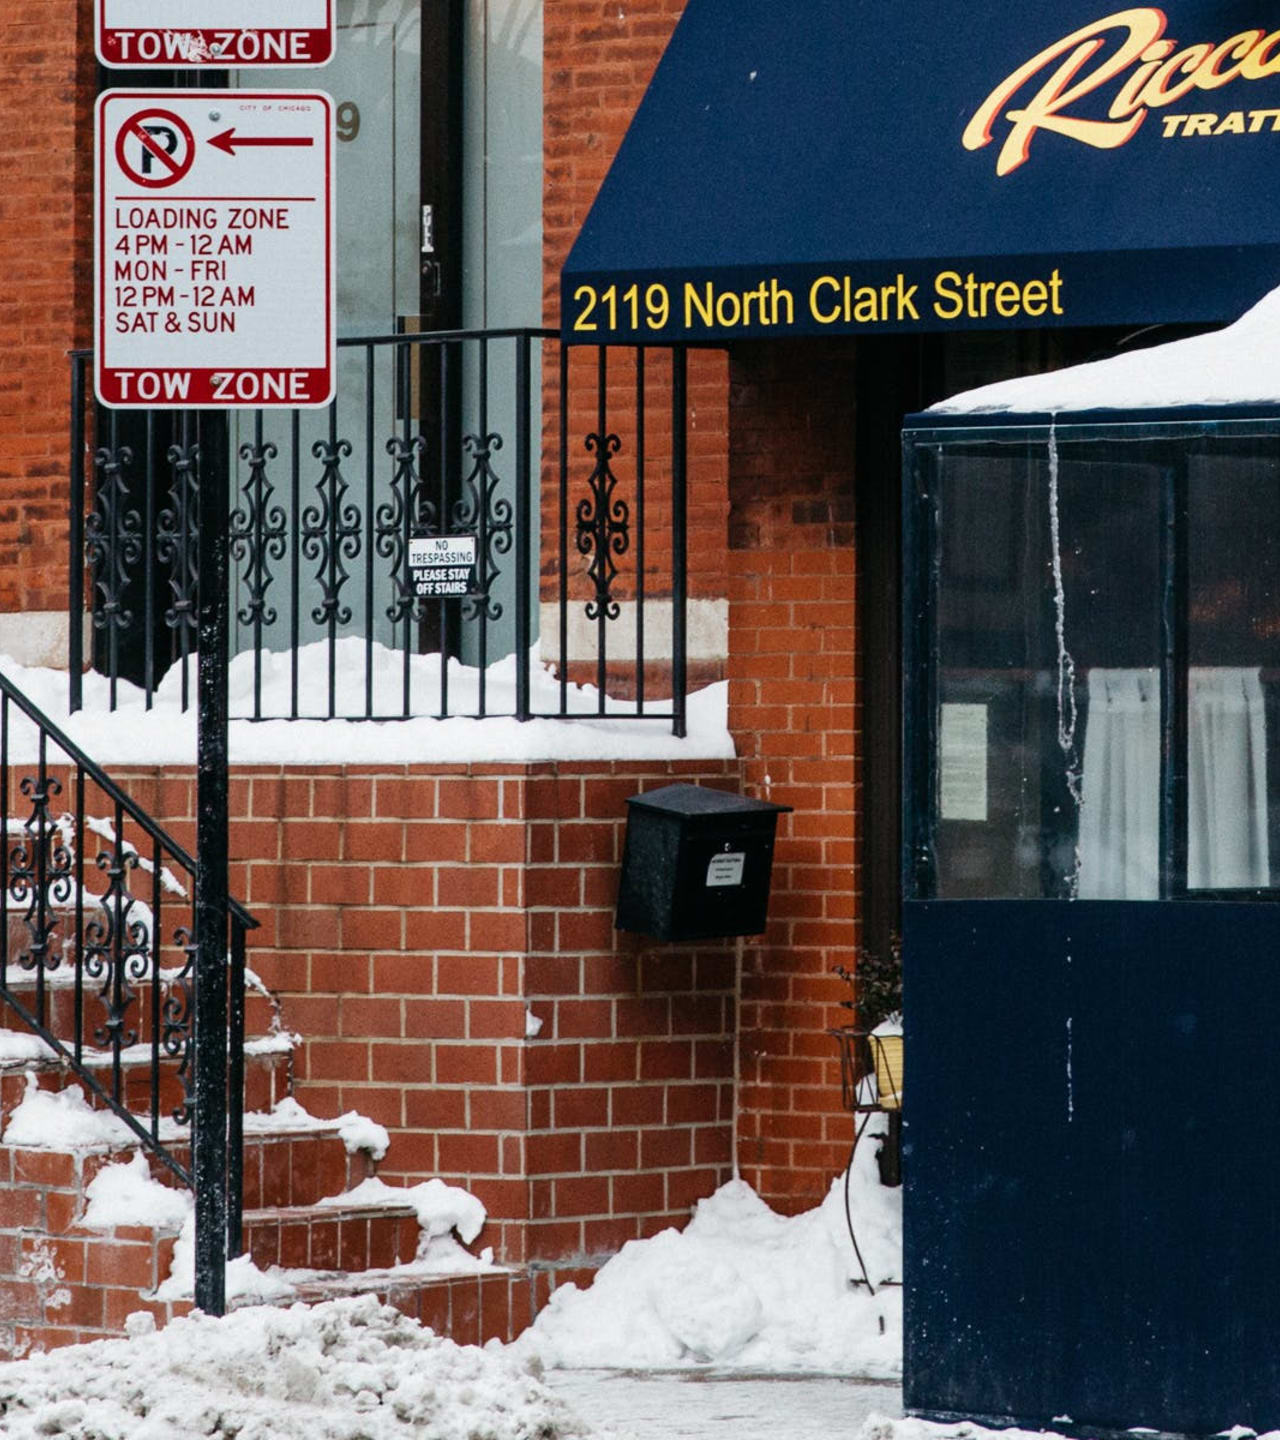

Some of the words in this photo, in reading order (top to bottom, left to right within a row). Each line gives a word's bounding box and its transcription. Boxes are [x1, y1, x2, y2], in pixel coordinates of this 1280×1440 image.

[115, 32, 191, 60] TOW
[213, 32, 312, 60] ZONE
[115, 208, 218, 229] LOADING
[227, 208, 290, 229] ZONE
[115, 234, 131, 255] 4
[135, 234, 168, 255] PM
[190, 234, 213, 255] 12
[218, 234, 253, 255] AM
[115, 260, 167, 281] MON
[191, 260, 227, 281] FRI
[115, 286, 137, 307] 12
[142, 286, 175, 307] PM
[193, 286, 215, 307] 12
[219, 286, 255, 307] AM
[573, 282, 670, 331] 2119
[684, 277, 794, 328] North
[809, 273, 920, 324] Clark
[933, 268, 1064, 319] Street
[115, 311, 159, 333] SAT
[164, 311, 182, 333] &
[187, 311, 236, 333] SUN
[114, 372, 191, 400] TOW
[212, 371, 310, 400] ZONE
[435, 540, 448, 551] NO
[412, 552, 472, 563] TRESPASSING
[413, 569, 447, 581] PLEASE
[447, 568, 470, 580] STAY
[416, 582, 434, 594] OFF
[434, 581, 467, 594] STAIRS
